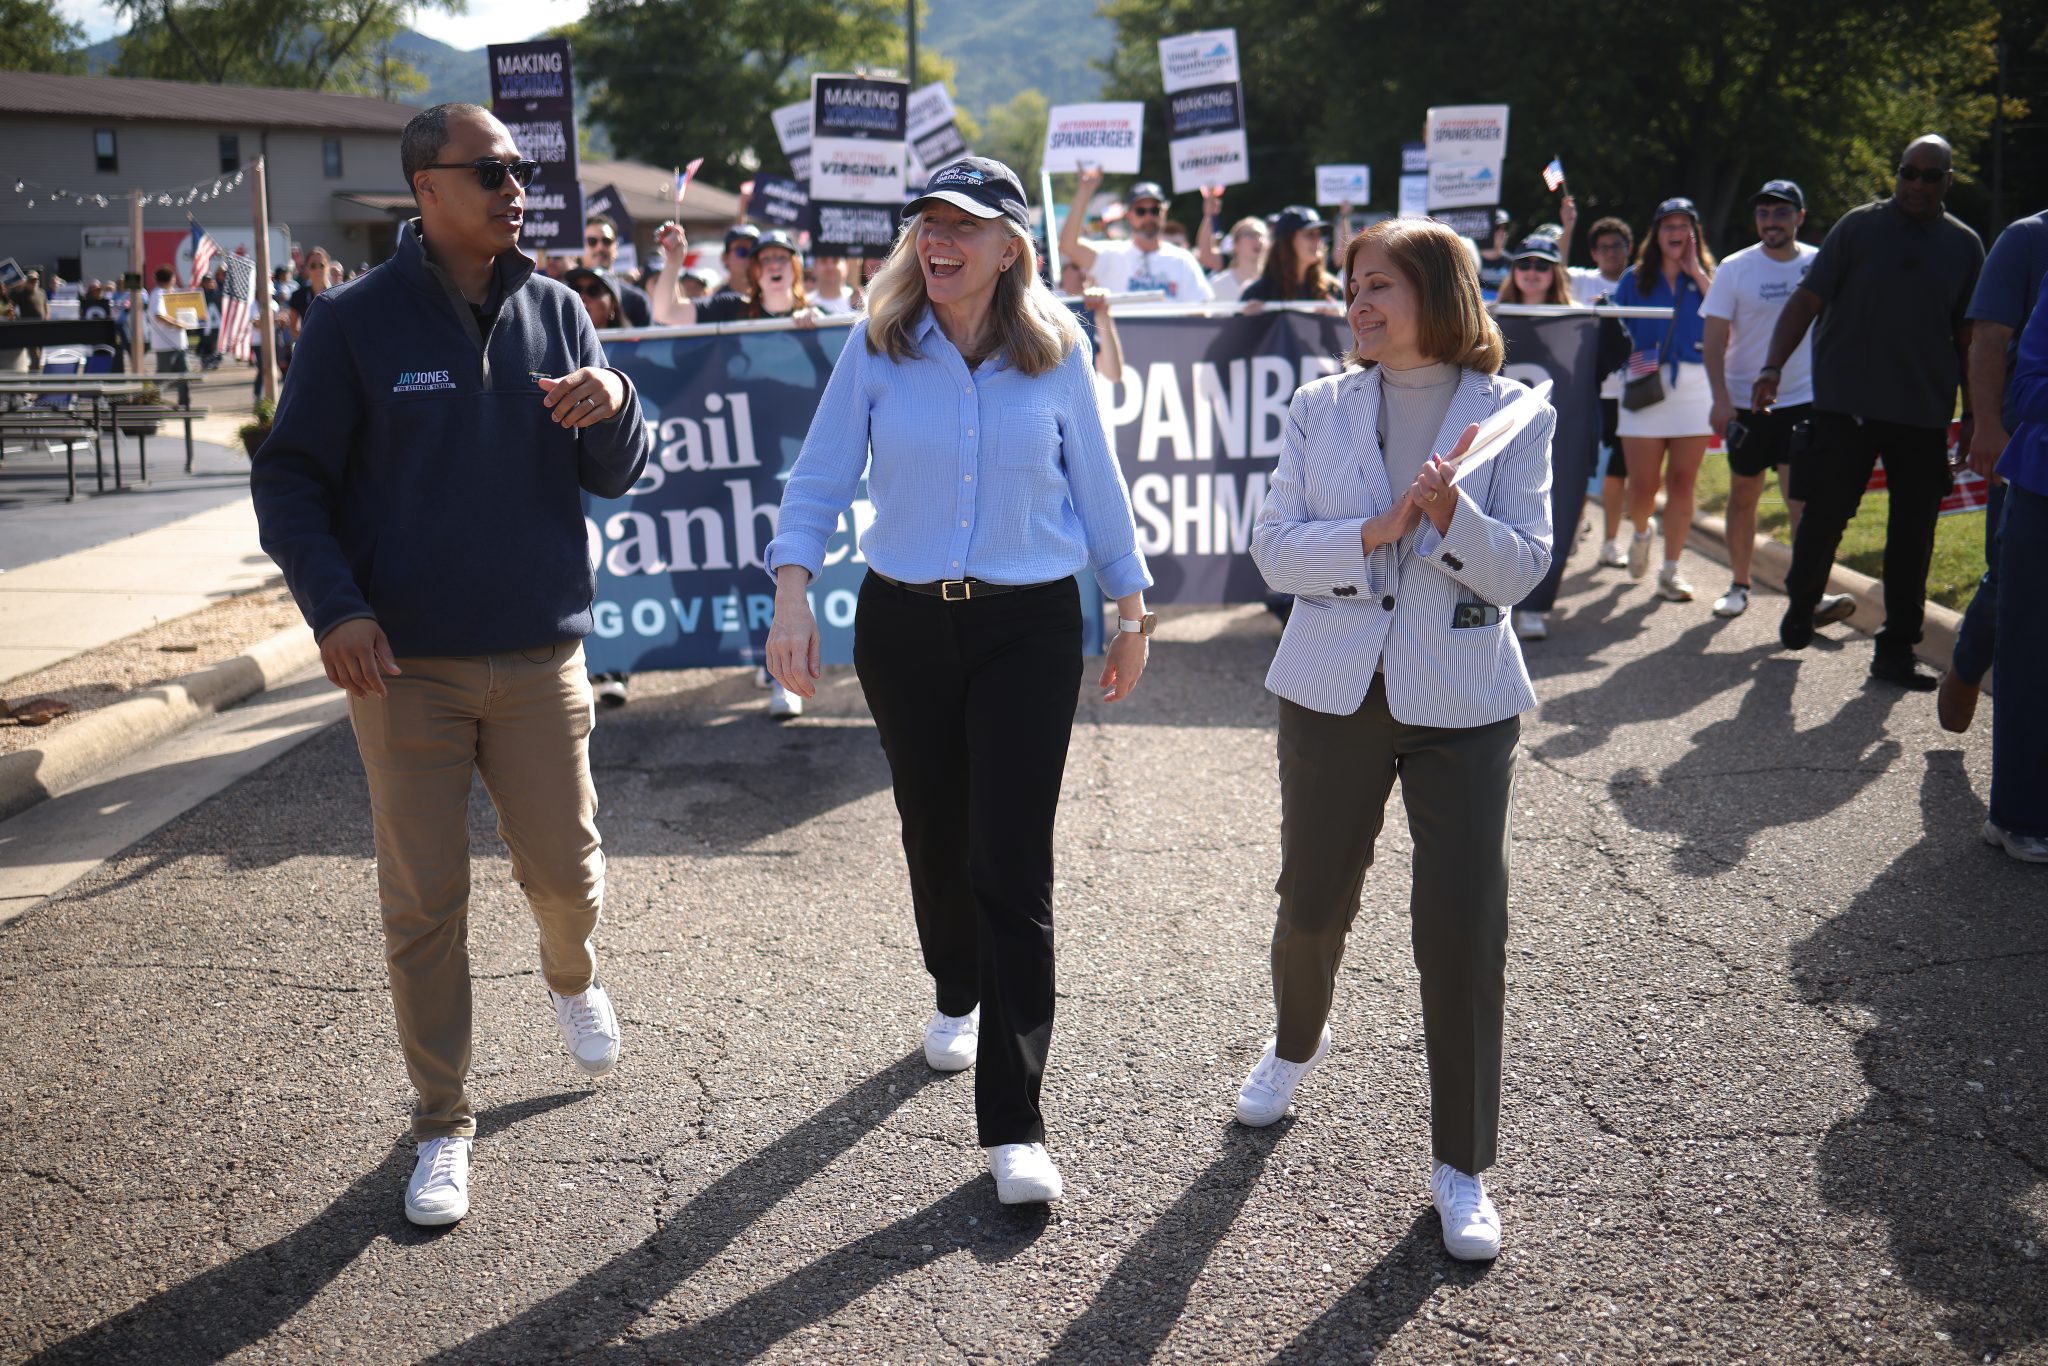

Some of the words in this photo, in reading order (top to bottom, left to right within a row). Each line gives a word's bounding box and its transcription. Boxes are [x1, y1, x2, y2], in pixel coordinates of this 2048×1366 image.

[497, 52, 563, 75] MAKING
[824, 87, 900, 111] MAKING
[1049, 129, 1135, 150] SPANBERGER
[1433, 127, 1502, 142] SPANBERGER
[820, 161, 898, 178] VIRGINIA
